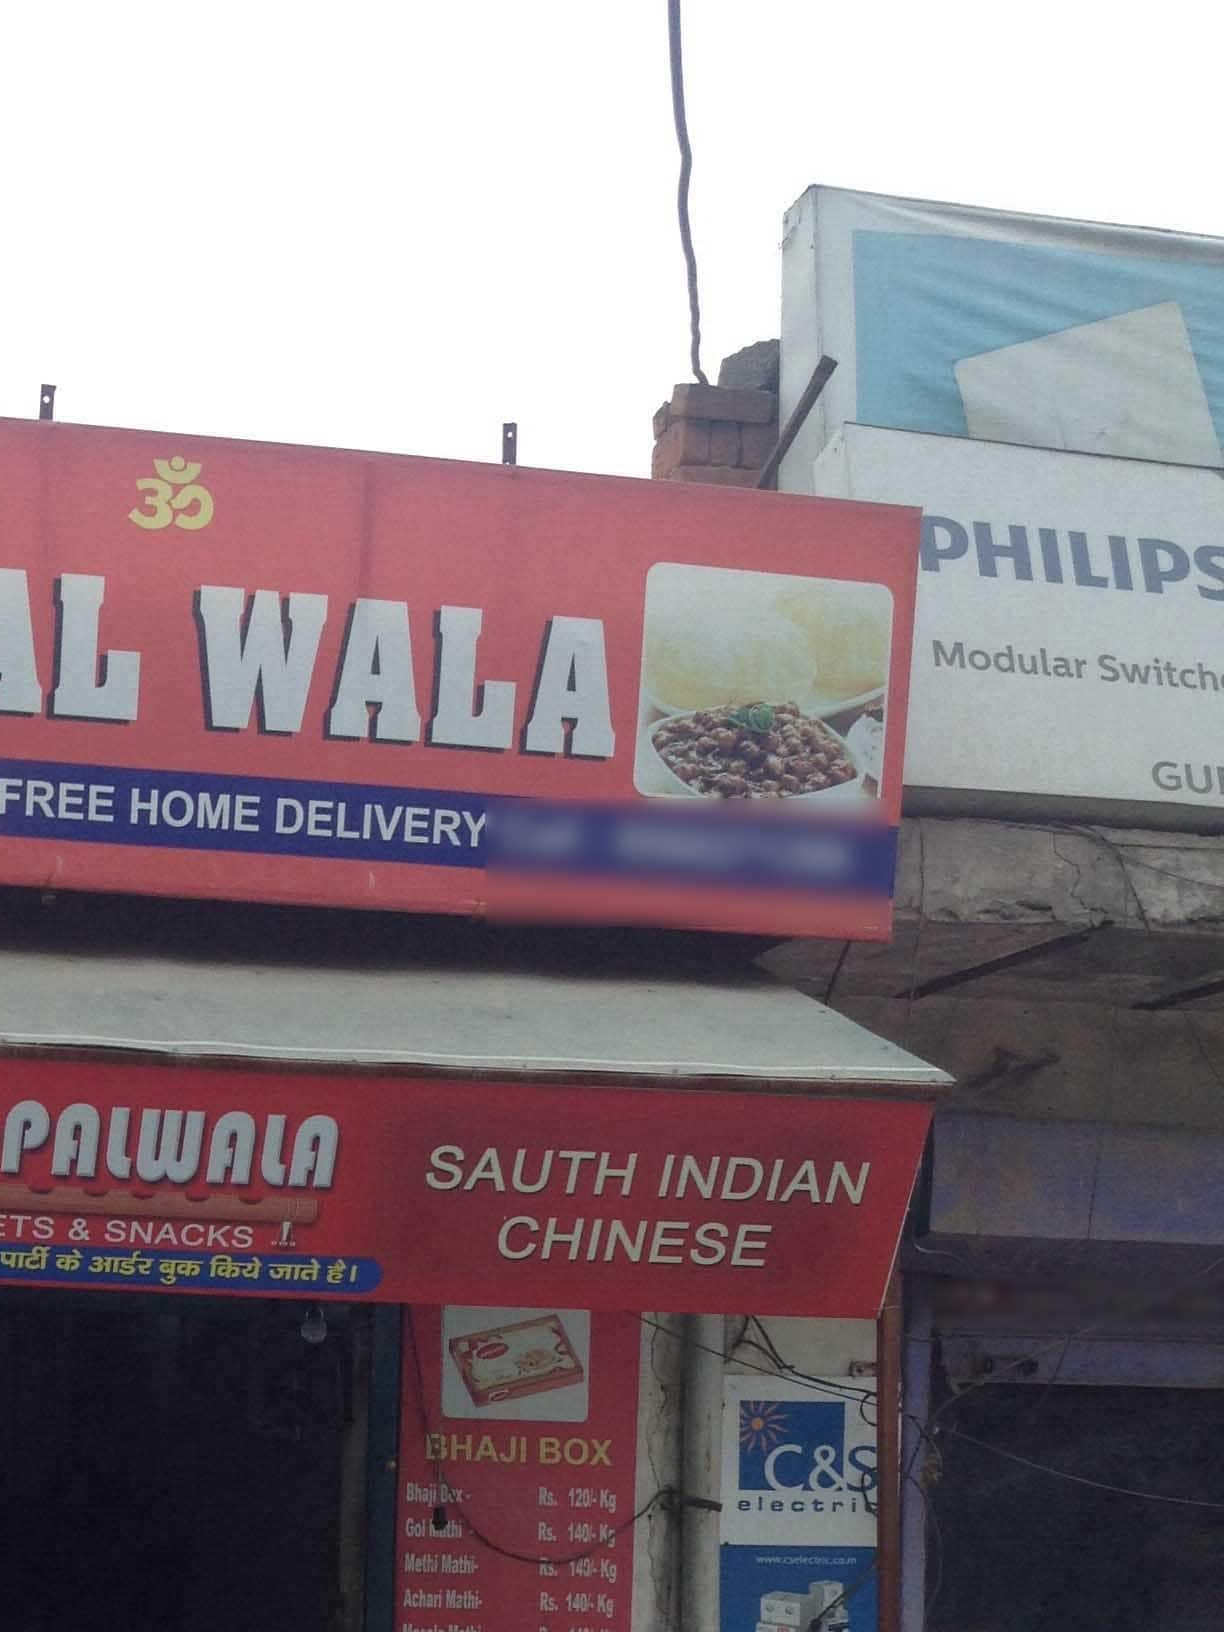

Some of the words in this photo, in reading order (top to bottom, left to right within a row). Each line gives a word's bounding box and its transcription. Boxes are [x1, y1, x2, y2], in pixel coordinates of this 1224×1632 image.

[922, 515, 1224, 602] PHILIPS
[193, 585, 614, 761] WALA
[932, 639, 1087, 680] Modular
[1098, 654, 1224, 691] Switch
[130, 788, 260, 833] HOME
[275, 798, 487, 849] DELIVERY
[424, 1144, 638, 1199] SAUTH
[658, 1153, 871, 1205] INDIAN
[68, 1217, 91, 1241] &
[104, 1219, 254, 1249] SNACKS
[497, 1215, 772, 1268] CHINESE
[0, 1245, 51, 1270] पार्टी
[55, 1249, 82, 1273] के
[88, 1250, 154, 1276] आर्डर
[159, 1260, 204, 1285] बुक
[209, 1254, 264, 1280] किये
[267, 1258, 321, 1281] जाते
[426, 1434, 526, 1463] BHAJI
[539, 1437, 612, 1467] BOX
[406, 1482, 437, 1507] Bhaji
[538, 1487, 558, 1506] Rs.
[600, 1490, 617, 1513] Kg
[538, 1522, 557, 1542] Rs.
[404, 1554, 439, 1574] Methi
[600, 1561, 617, 1584] Kg
[403, 1589, 443, 1609] Achari
[539, 1592, 559, 1612] Rs.
[597, 1595, 614, 1618] Kg
